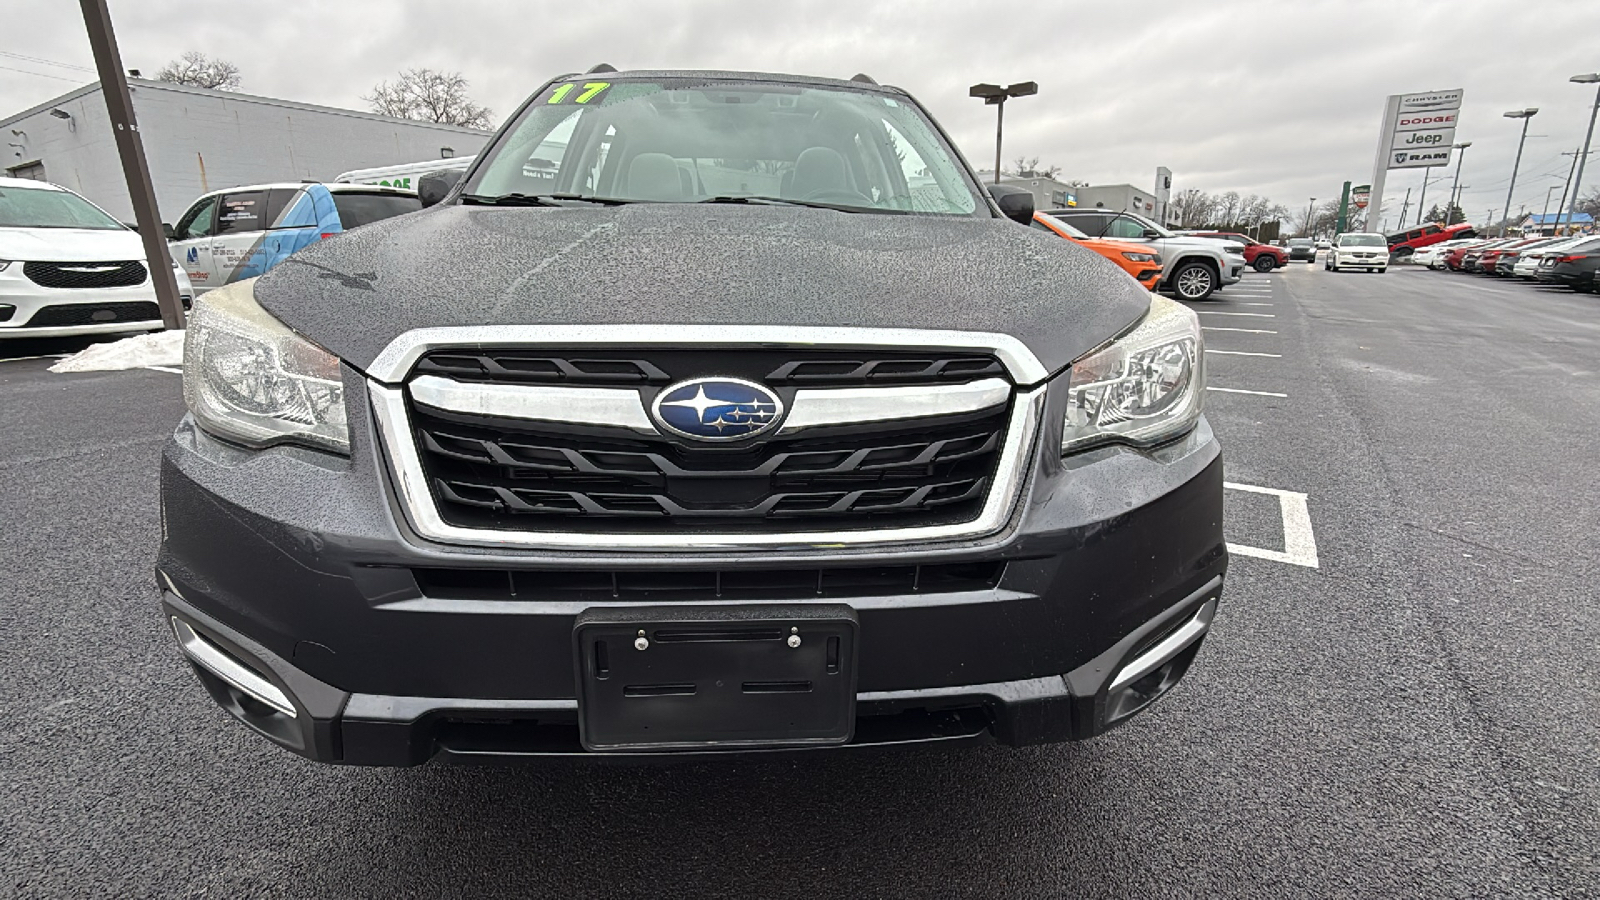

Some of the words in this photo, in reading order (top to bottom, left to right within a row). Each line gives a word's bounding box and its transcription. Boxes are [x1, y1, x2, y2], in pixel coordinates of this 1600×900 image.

[547, 83, 611, 104] 17
[1405, 94, 1458, 103] CHRYSLER
[1400, 115, 1456, 125] DODGE
[1406, 133, 1443, 144] Jeep
[1409, 152, 1448, 161] RAM
